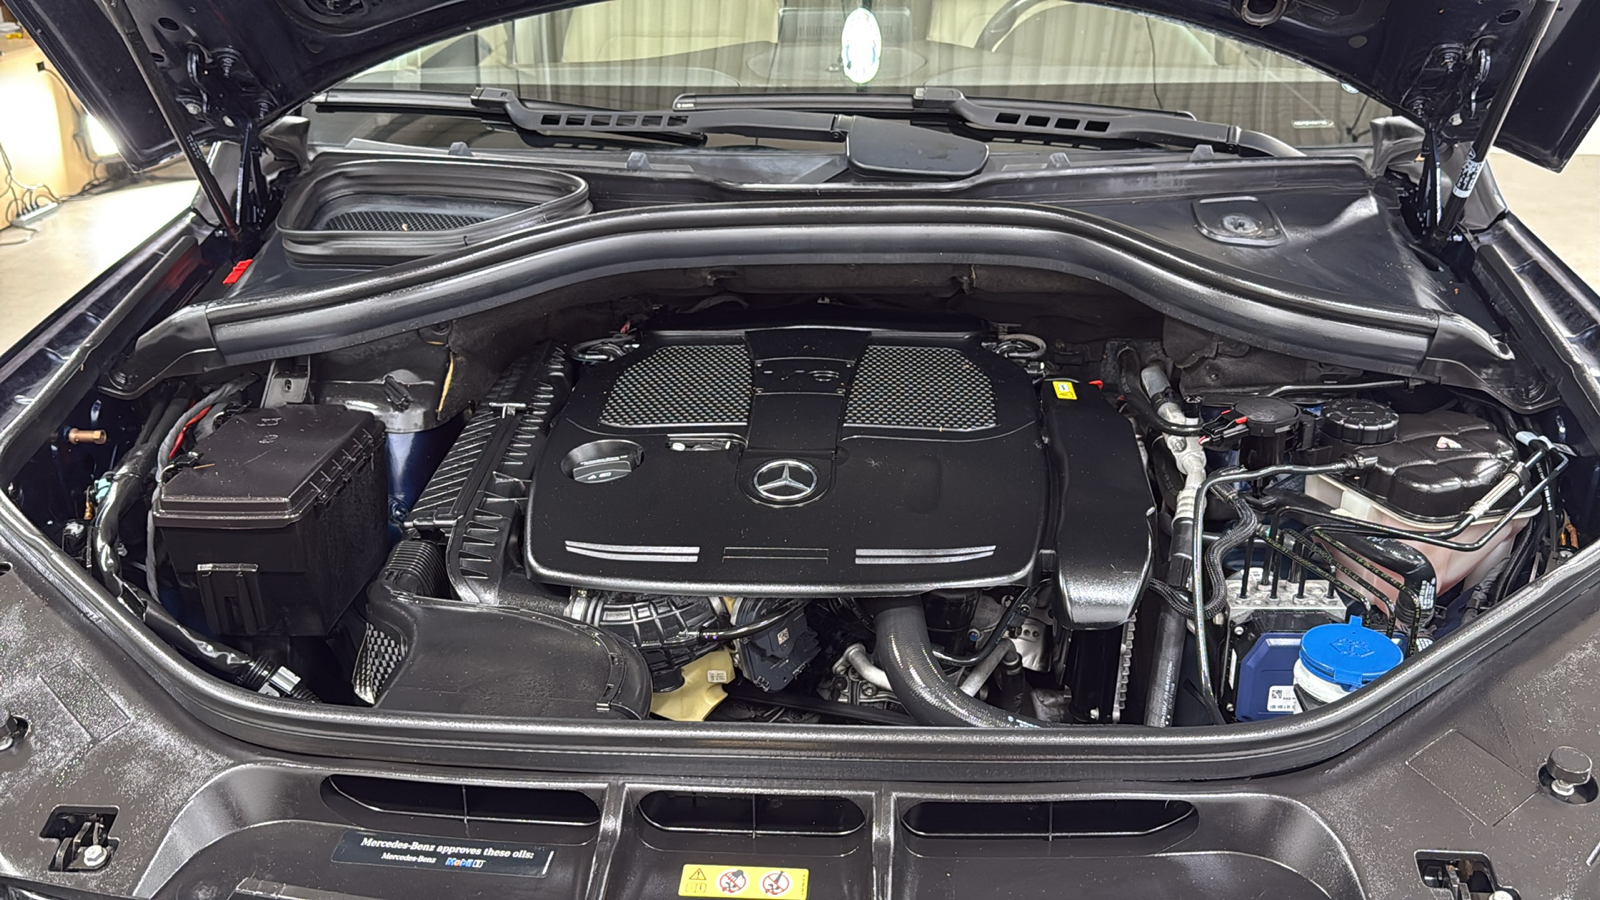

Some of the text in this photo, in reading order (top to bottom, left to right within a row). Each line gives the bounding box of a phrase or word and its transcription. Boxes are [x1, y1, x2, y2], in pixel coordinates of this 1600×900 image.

[360, 837, 534, 859] Mercedes-Benz approves these oils:
[380, 852, 437, 864] Mercedes-Benz
